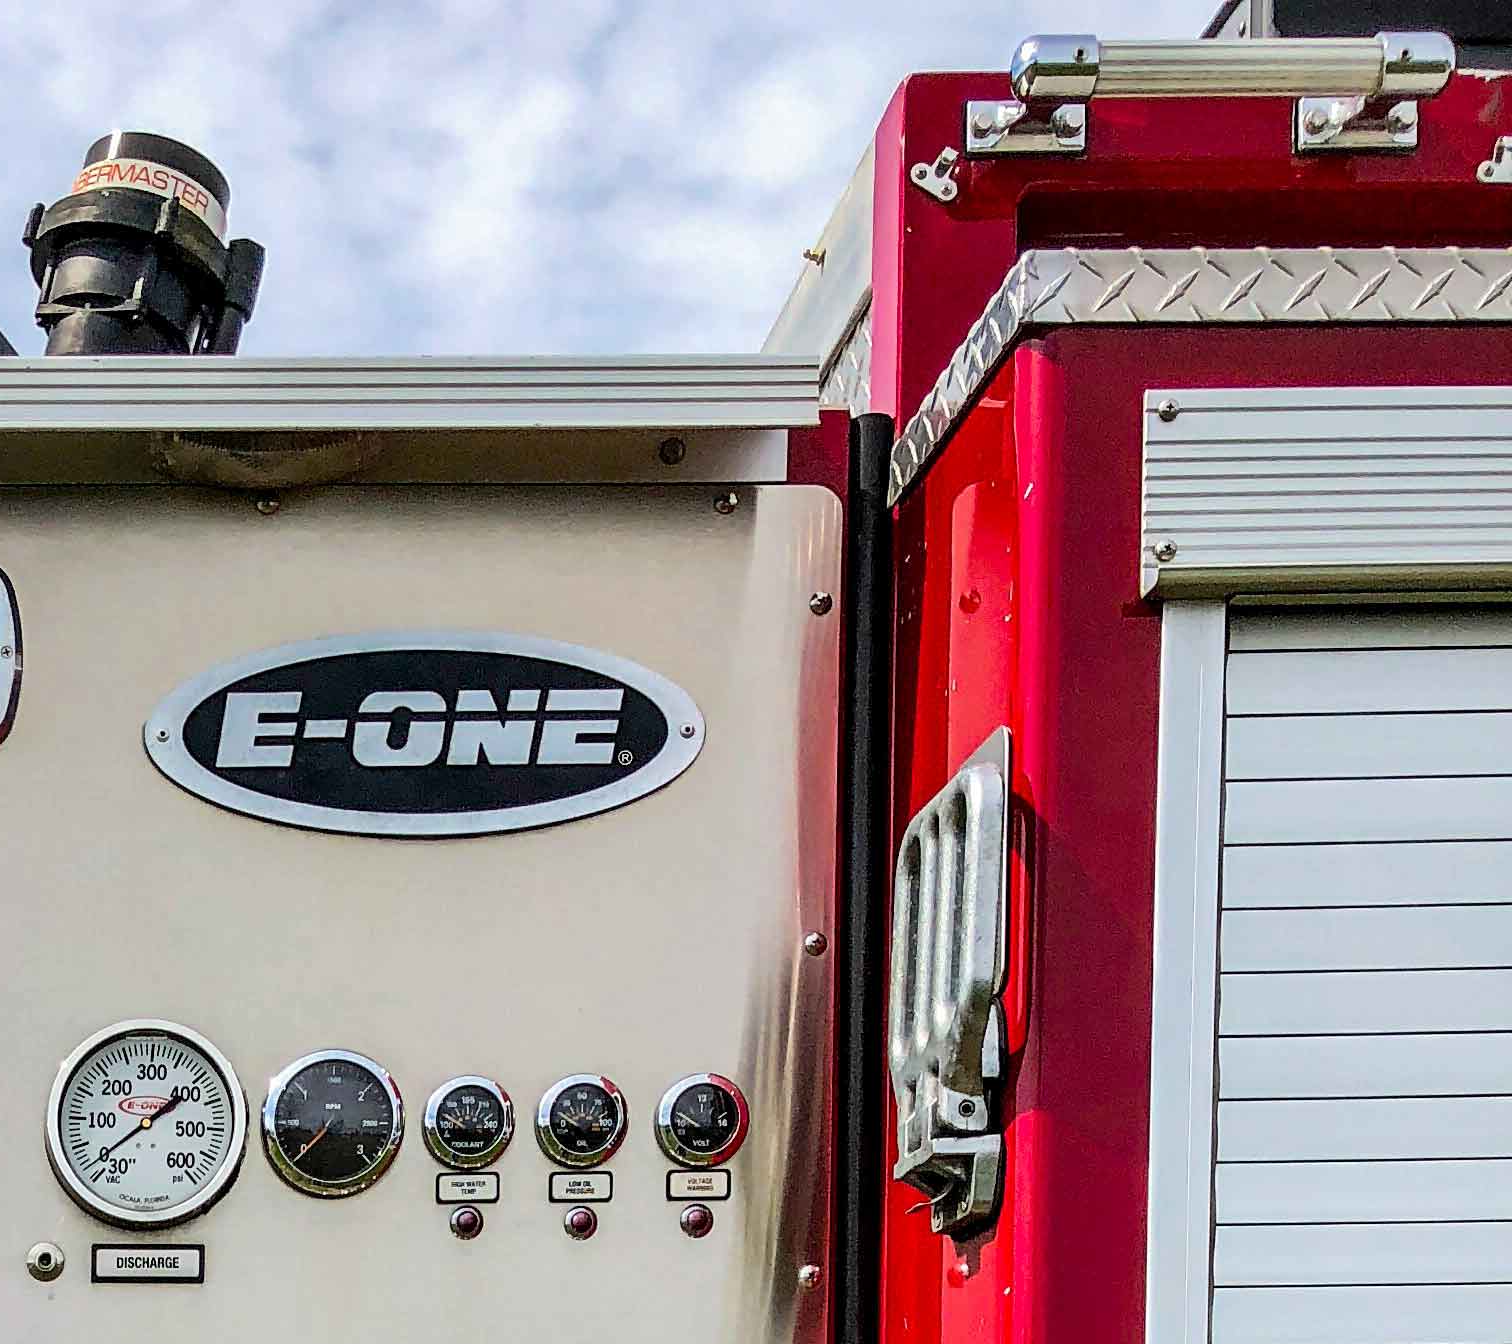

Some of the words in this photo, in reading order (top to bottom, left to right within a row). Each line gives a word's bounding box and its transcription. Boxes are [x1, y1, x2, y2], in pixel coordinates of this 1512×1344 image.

[215, 688, 624, 767] E-ONE
[136, 1064, 167, 1081] 300
[101, 1079, 132, 1096] 200
[88, 1112, 116, 1129] 100
[175, 1121, 205, 1138] 500
[166, 1151, 196, 1168] 600
[116, 1256, 180, 1270] DISCHARGE
